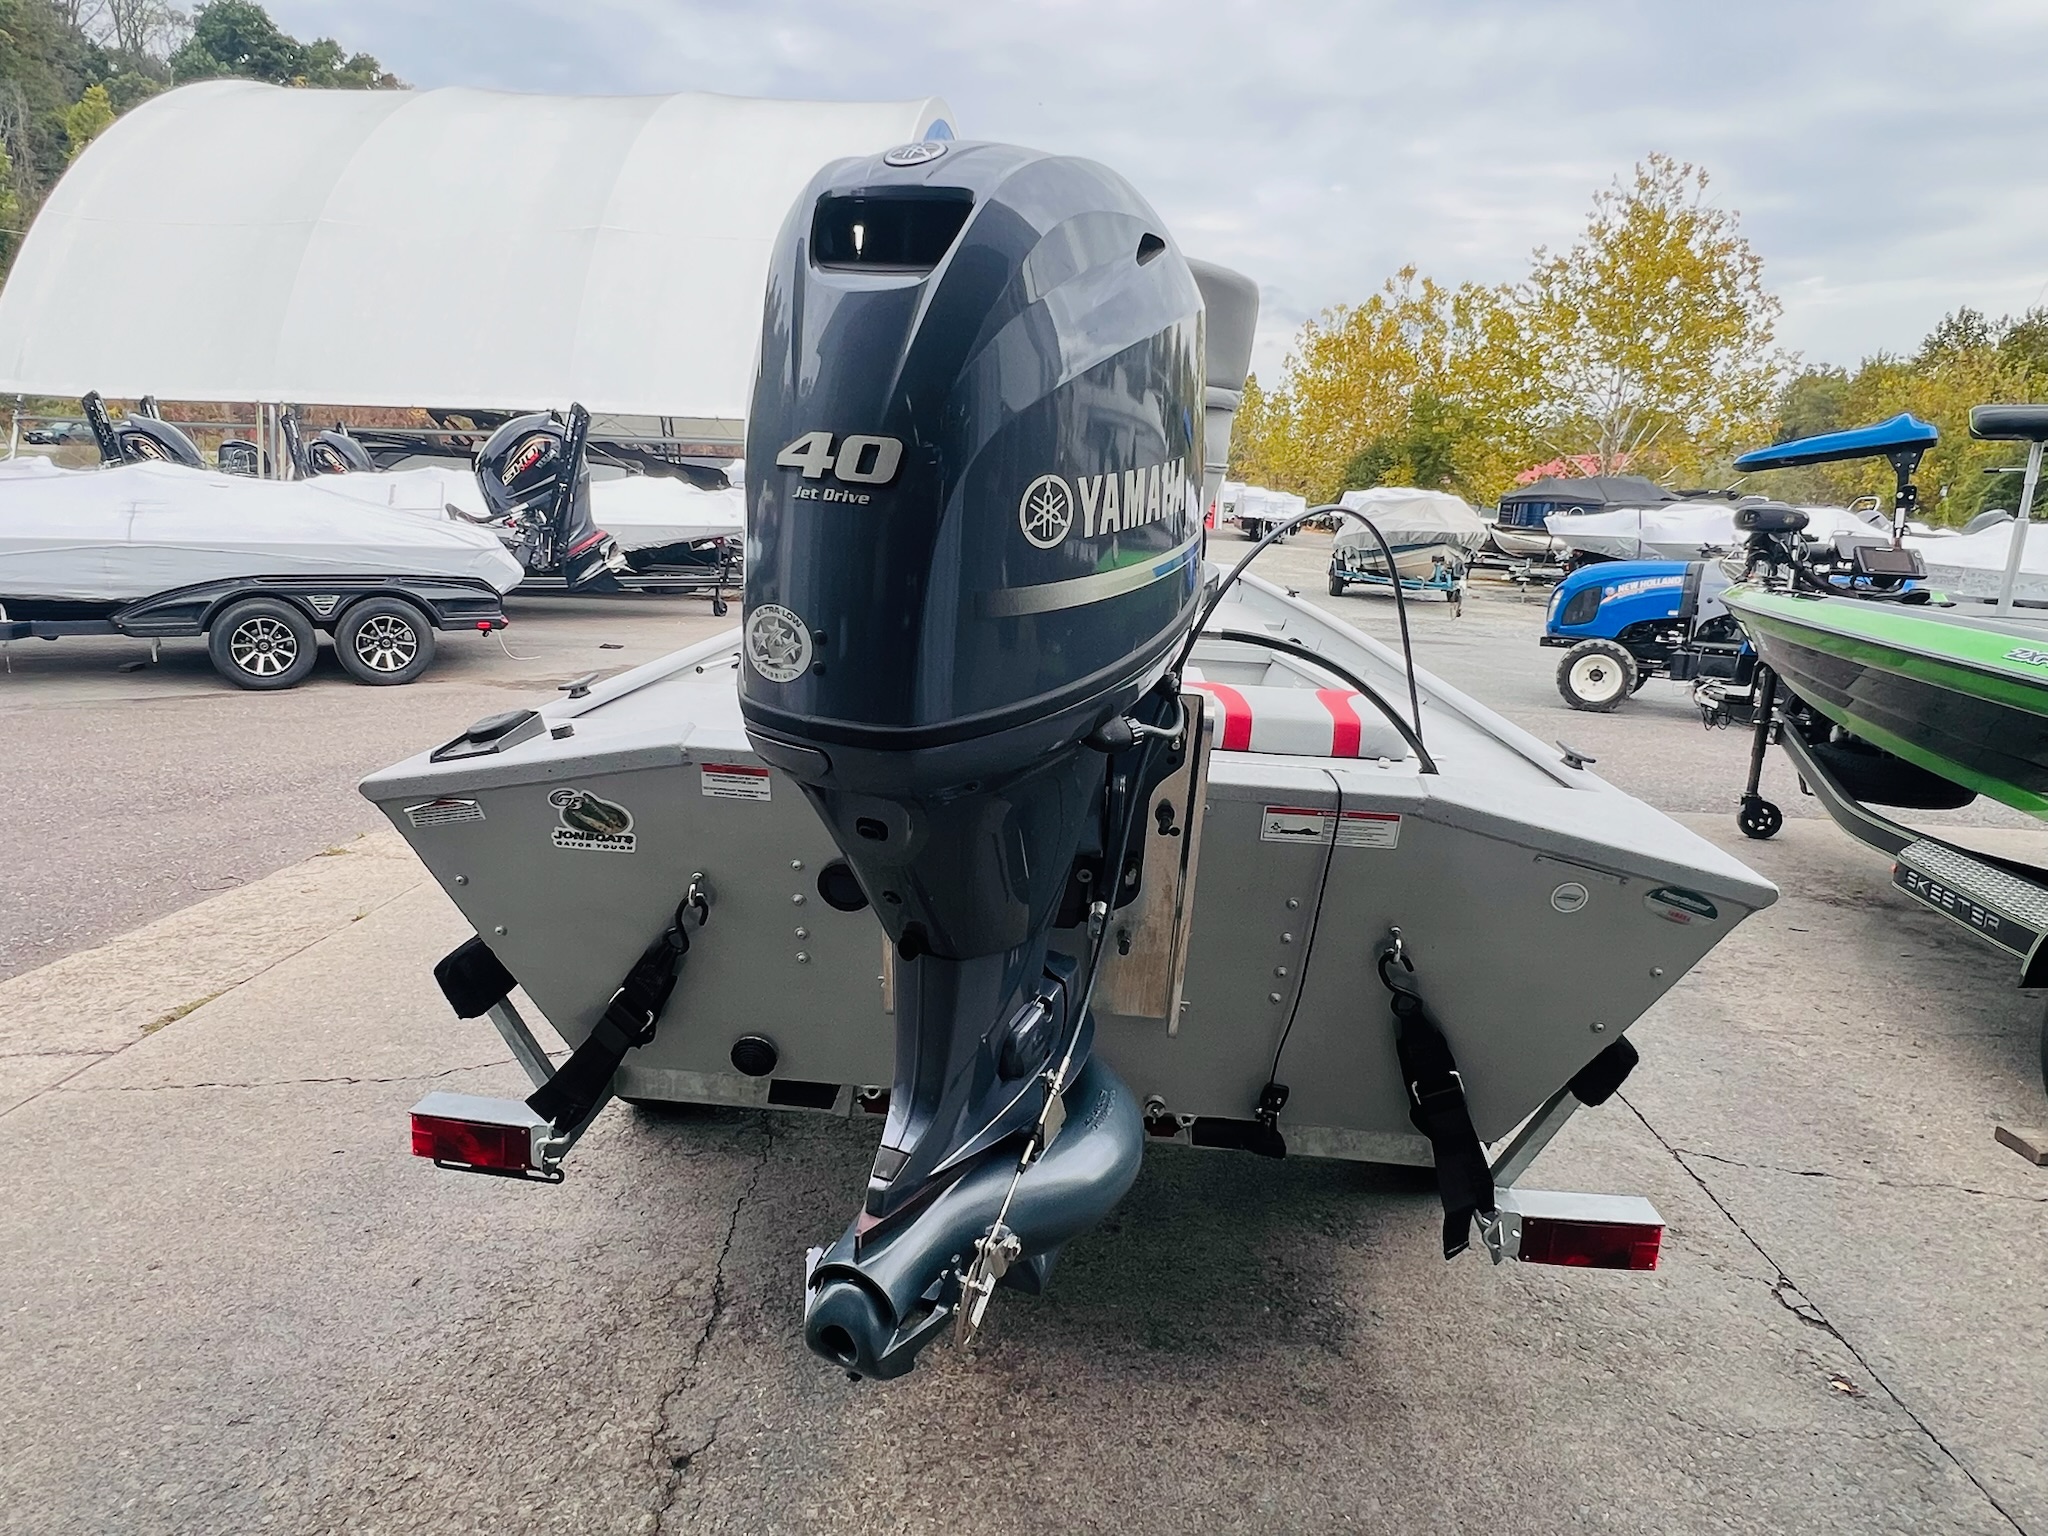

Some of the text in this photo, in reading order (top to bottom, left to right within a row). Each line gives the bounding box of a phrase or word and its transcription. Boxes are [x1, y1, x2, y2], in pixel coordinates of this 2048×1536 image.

[776, 431, 903, 484] 40
[792, 486, 870, 505] Jet Drive
[1077, 457, 1185, 538] YAMAHA
[1617, 576, 1682, 593] NEW HOLLAND
[755, 606, 802, 628] ULTRA LOW
[549, 790, 586, 810] G3
[1906, 870, 2000, 933] SKEETER
